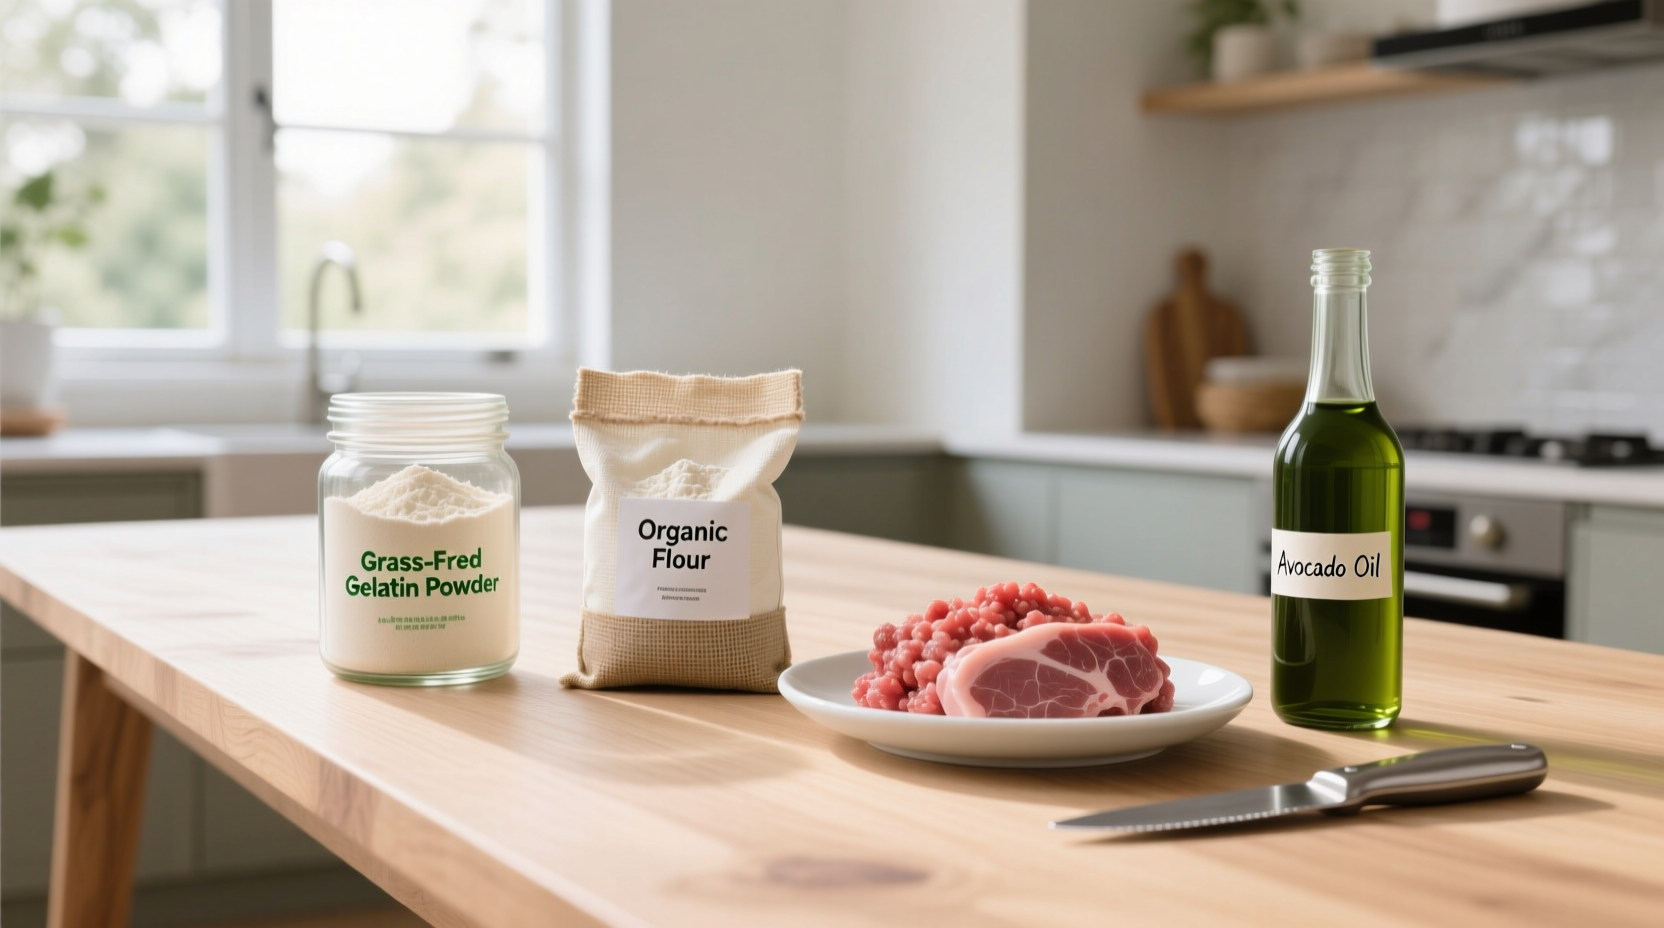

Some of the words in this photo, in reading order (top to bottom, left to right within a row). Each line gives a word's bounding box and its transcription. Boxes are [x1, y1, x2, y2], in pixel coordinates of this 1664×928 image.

[638, 518, 728, 546] Organic
[361, 547, 482, 572] Grass-Fred
[652, 548, 711, 570] Flour
[1277, 549, 1346, 577] Avocado
[1354, 552, 1380, 578] Oil
[345, 575, 419, 598] Gelatin
[426, 574, 499, 597] Powder
